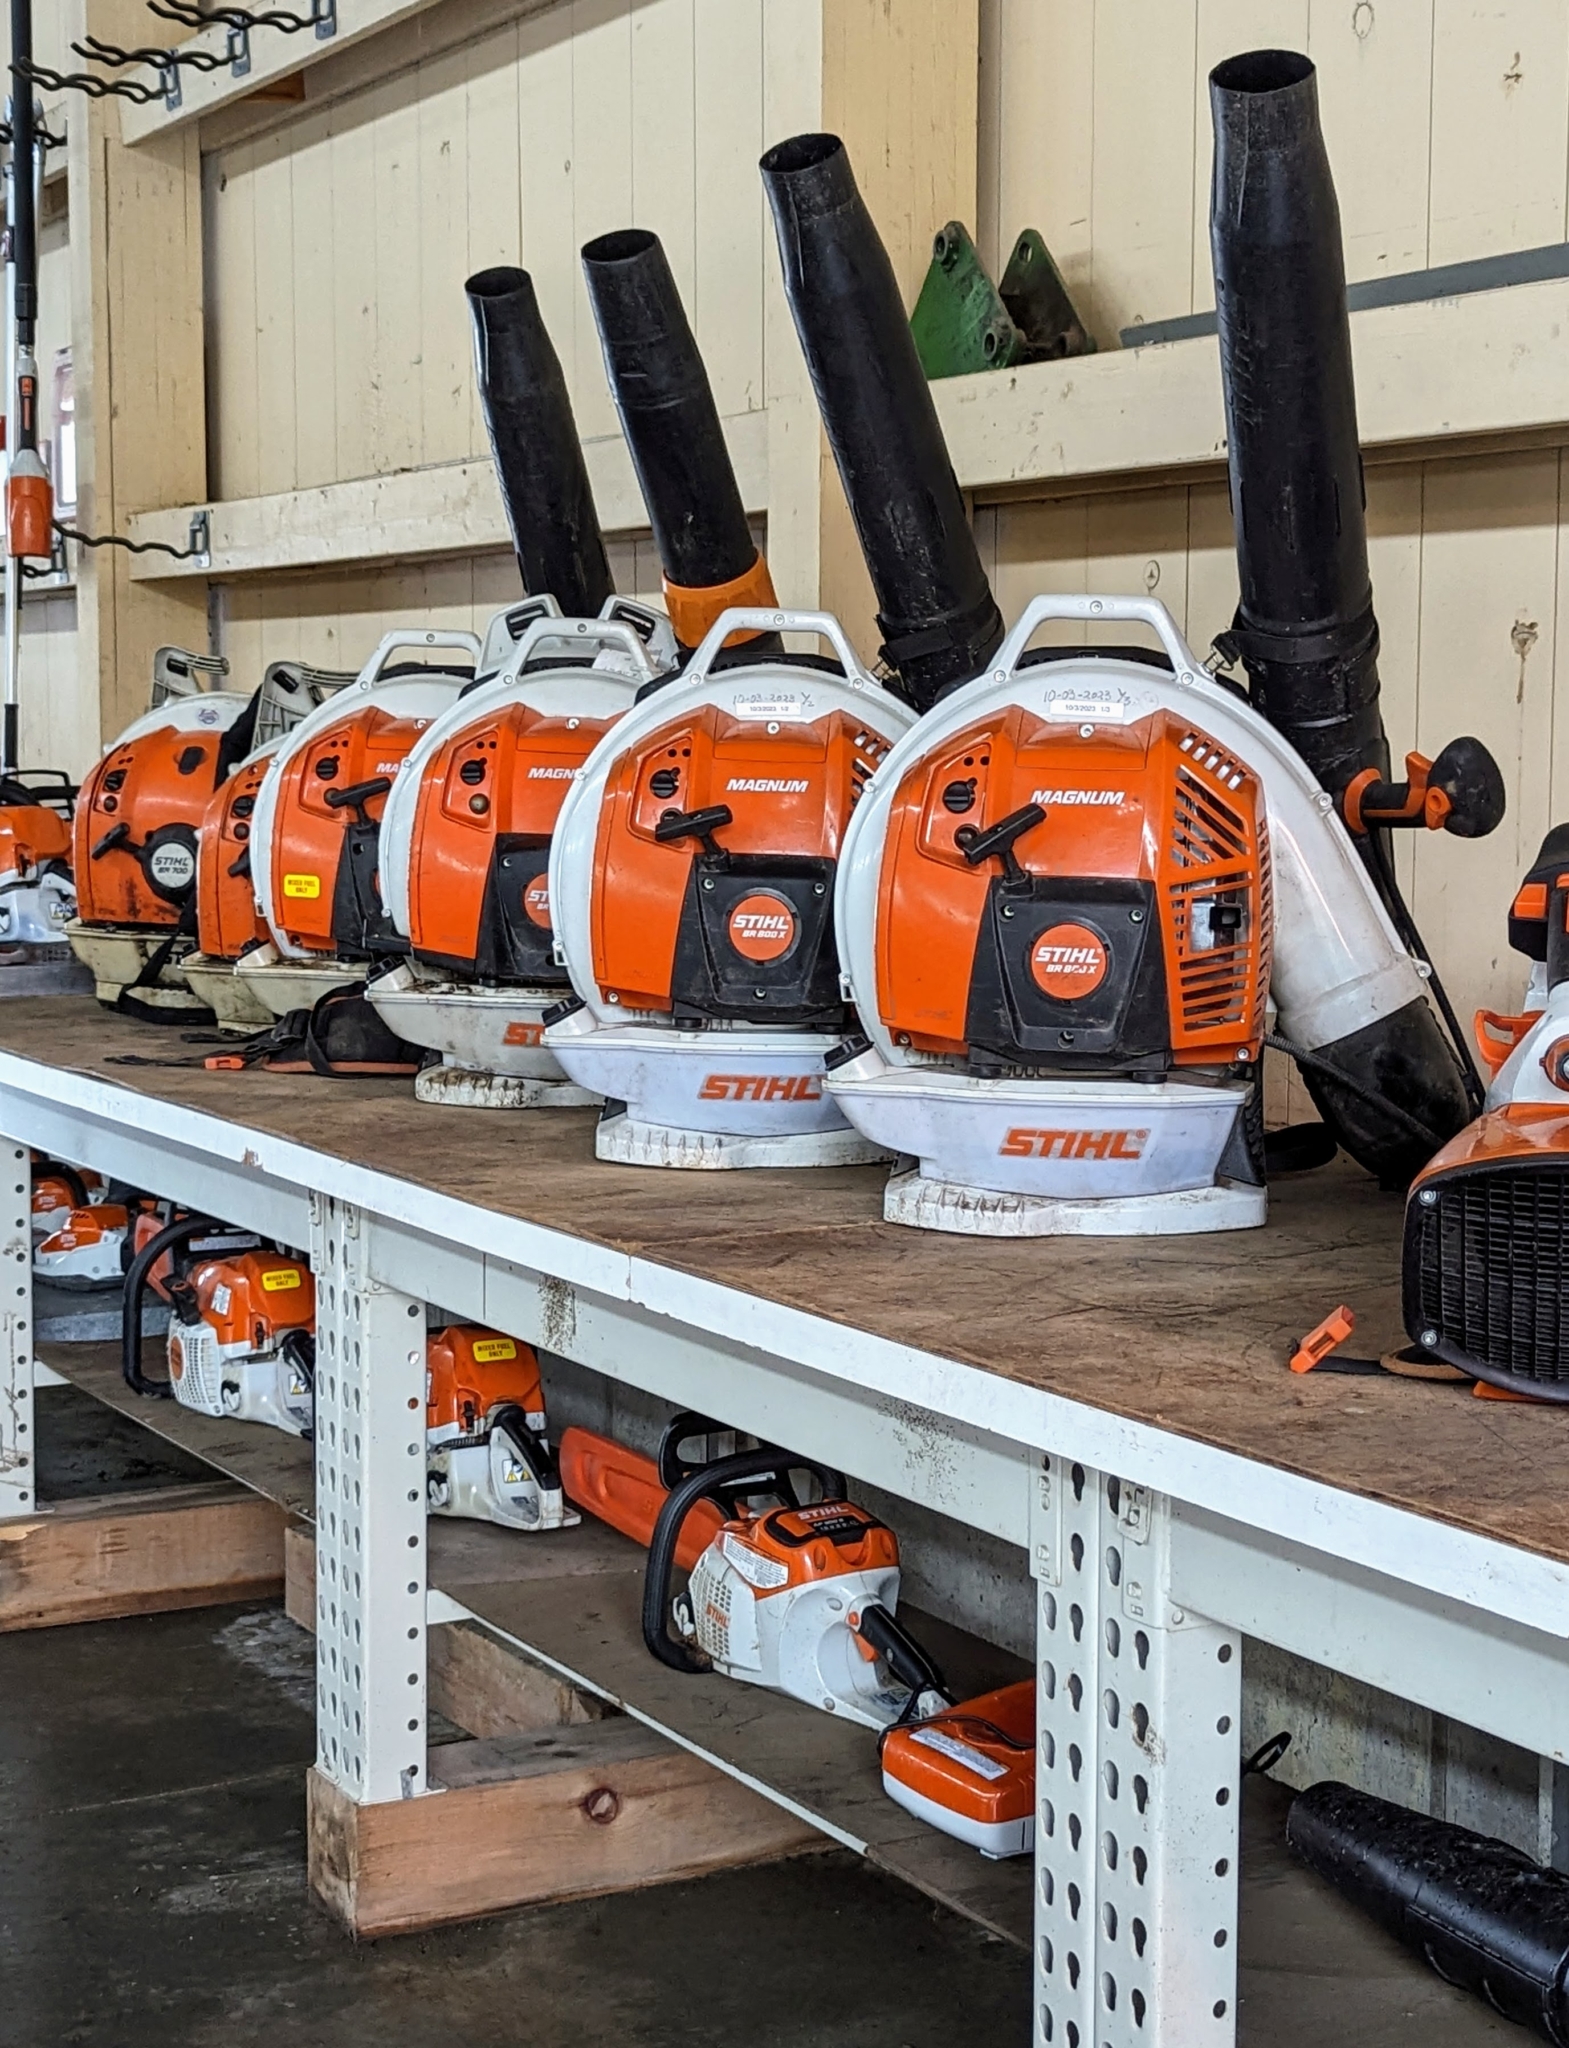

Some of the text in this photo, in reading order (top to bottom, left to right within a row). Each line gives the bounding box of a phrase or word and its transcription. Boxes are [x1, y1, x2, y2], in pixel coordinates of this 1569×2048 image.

[528, 768, 576, 779] MAGN
[726, 779, 809, 792] MAGNUM
[1030, 790, 1125, 805] MAGNUM
[154, 856, 189, 867] STIHL
[733, 914, 790, 930] STIHL
[1035, 946, 1101, 964] STIHL
[1046, 964, 1062, 973] BR
[1087, 965, 1097, 973] X
[701, 1075, 821, 1100] STIHL
[1001, 1128, 1142, 1159] STIHL
[798, 1506, 849, 1520] STIHL
